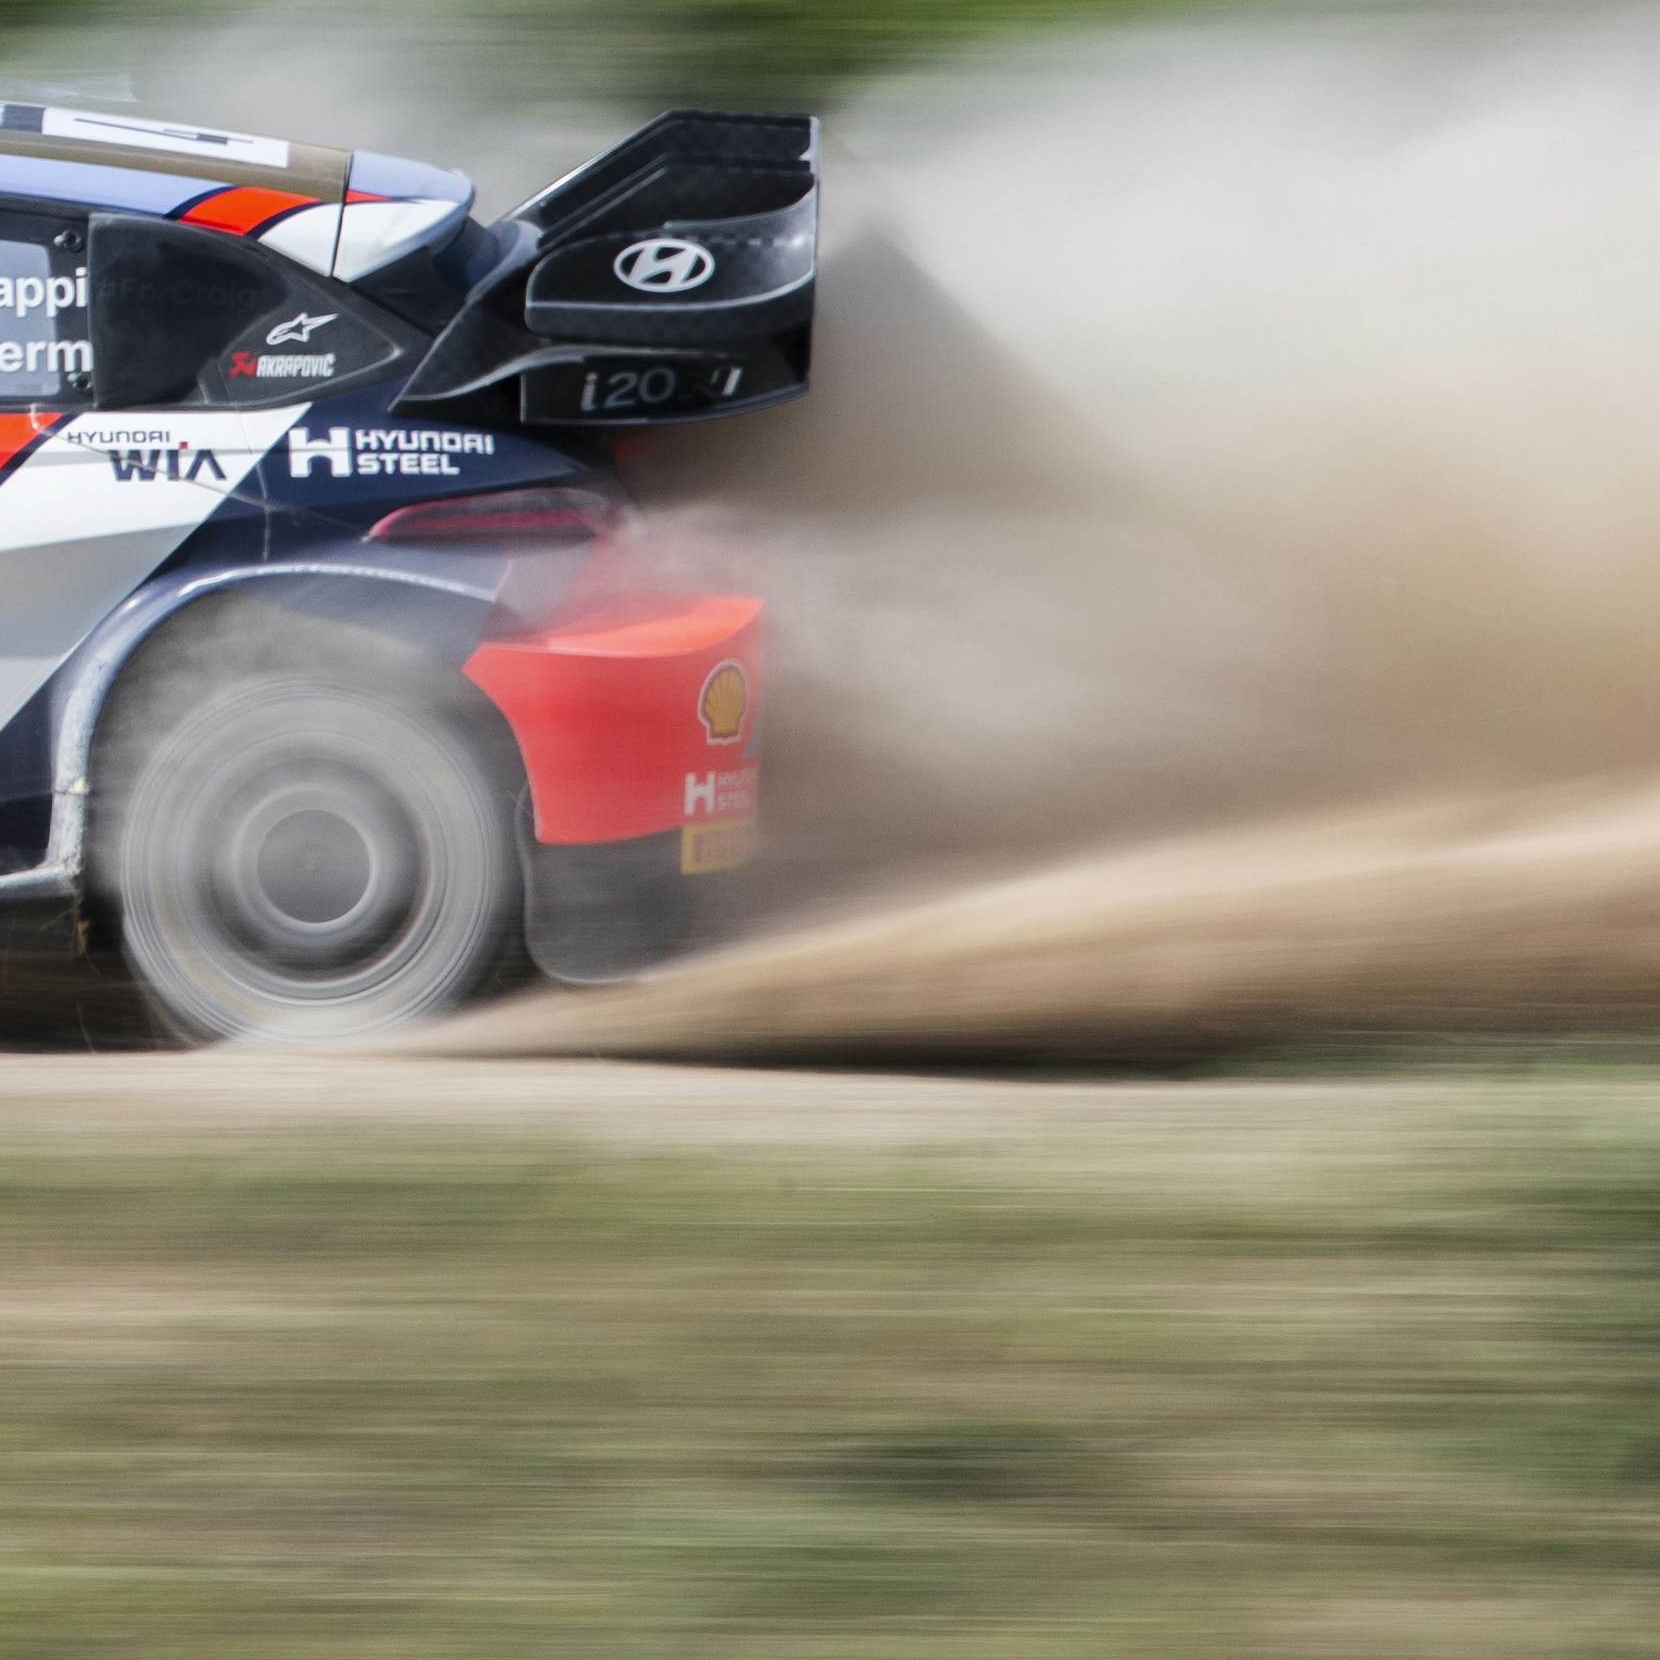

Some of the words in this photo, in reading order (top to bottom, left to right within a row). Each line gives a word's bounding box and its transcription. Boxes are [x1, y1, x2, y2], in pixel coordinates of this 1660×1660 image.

[581, 367, 677, 412] i20
[68, 430, 170, 444] HYUNDAI
[356, 429, 494, 455] HYUNDAI
[108, 441, 227, 481] WIA
[357, 453, 460, 476] STEEL
